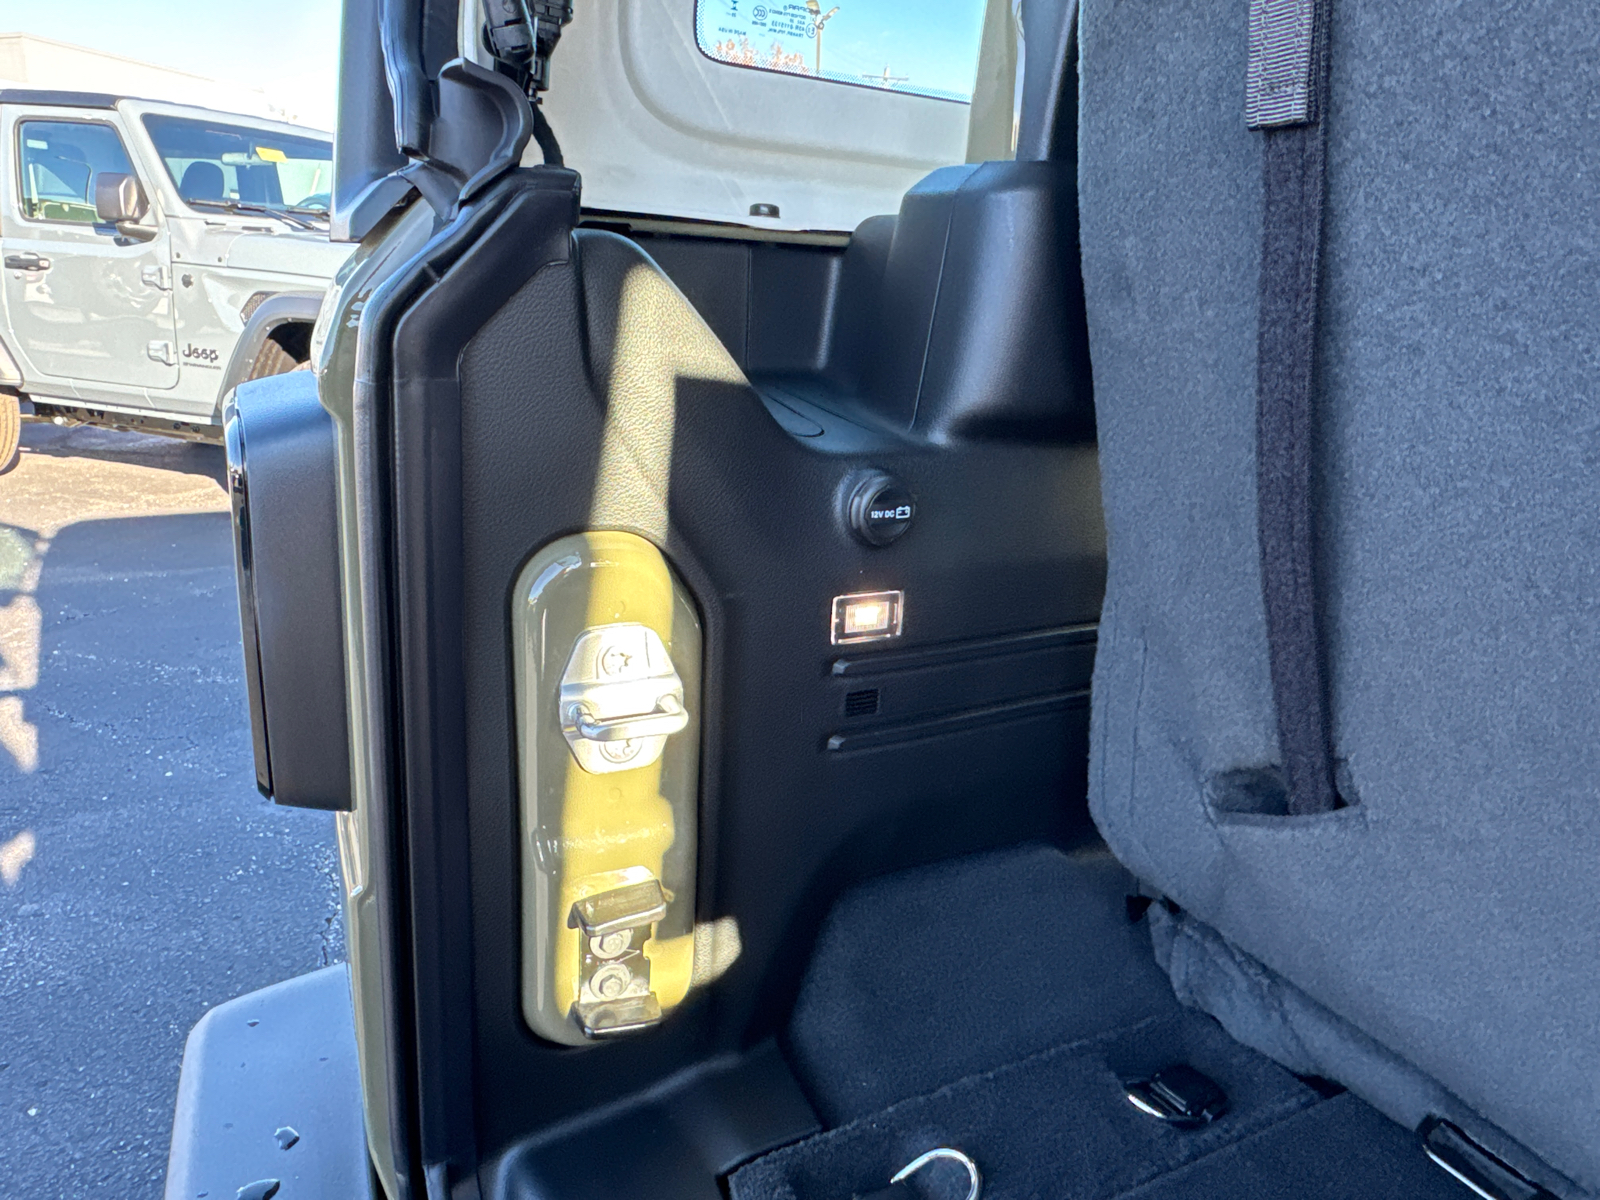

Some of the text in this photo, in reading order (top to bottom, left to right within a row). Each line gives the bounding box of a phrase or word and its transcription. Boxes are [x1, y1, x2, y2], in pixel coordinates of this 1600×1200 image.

[182, 342, 219, 363] Jeep
[870, 509, 895, 519] 12V DC
